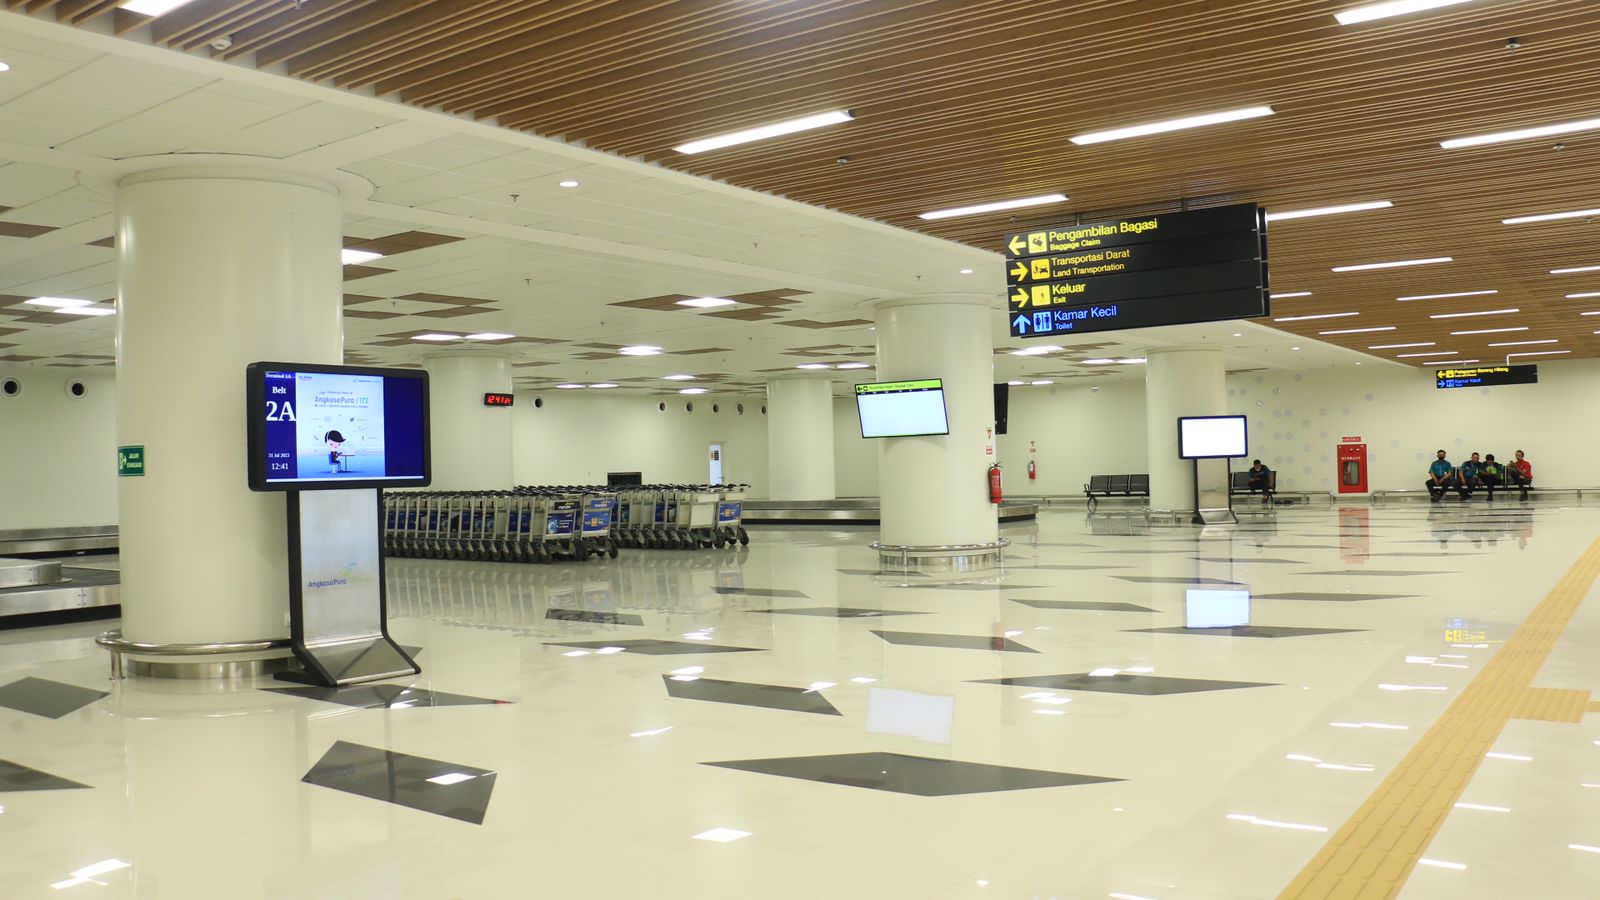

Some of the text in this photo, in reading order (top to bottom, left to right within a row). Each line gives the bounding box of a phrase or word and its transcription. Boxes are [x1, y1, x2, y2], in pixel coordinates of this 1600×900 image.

[1049, 218, 1158, 242] Pengambilan Bagasi
[1050, 239, 1101, 251] Baggage Claim
[1051, 249, 1130, 266] Transportasi Darat
[1053, 263, 1125, 278] Land Transportation
[1052, 283, 1086, 295] Keluar
[1053, 296, 1066, 304] Exit
[1054, 305, 1117, 321] Kamar Kecil
[1055, 322, 1073, 330] Toilet
[272, 386, 287, 394] Belt
[266, 400, 297, 422] 2A
[272, 462, 289, 470] 12:41
